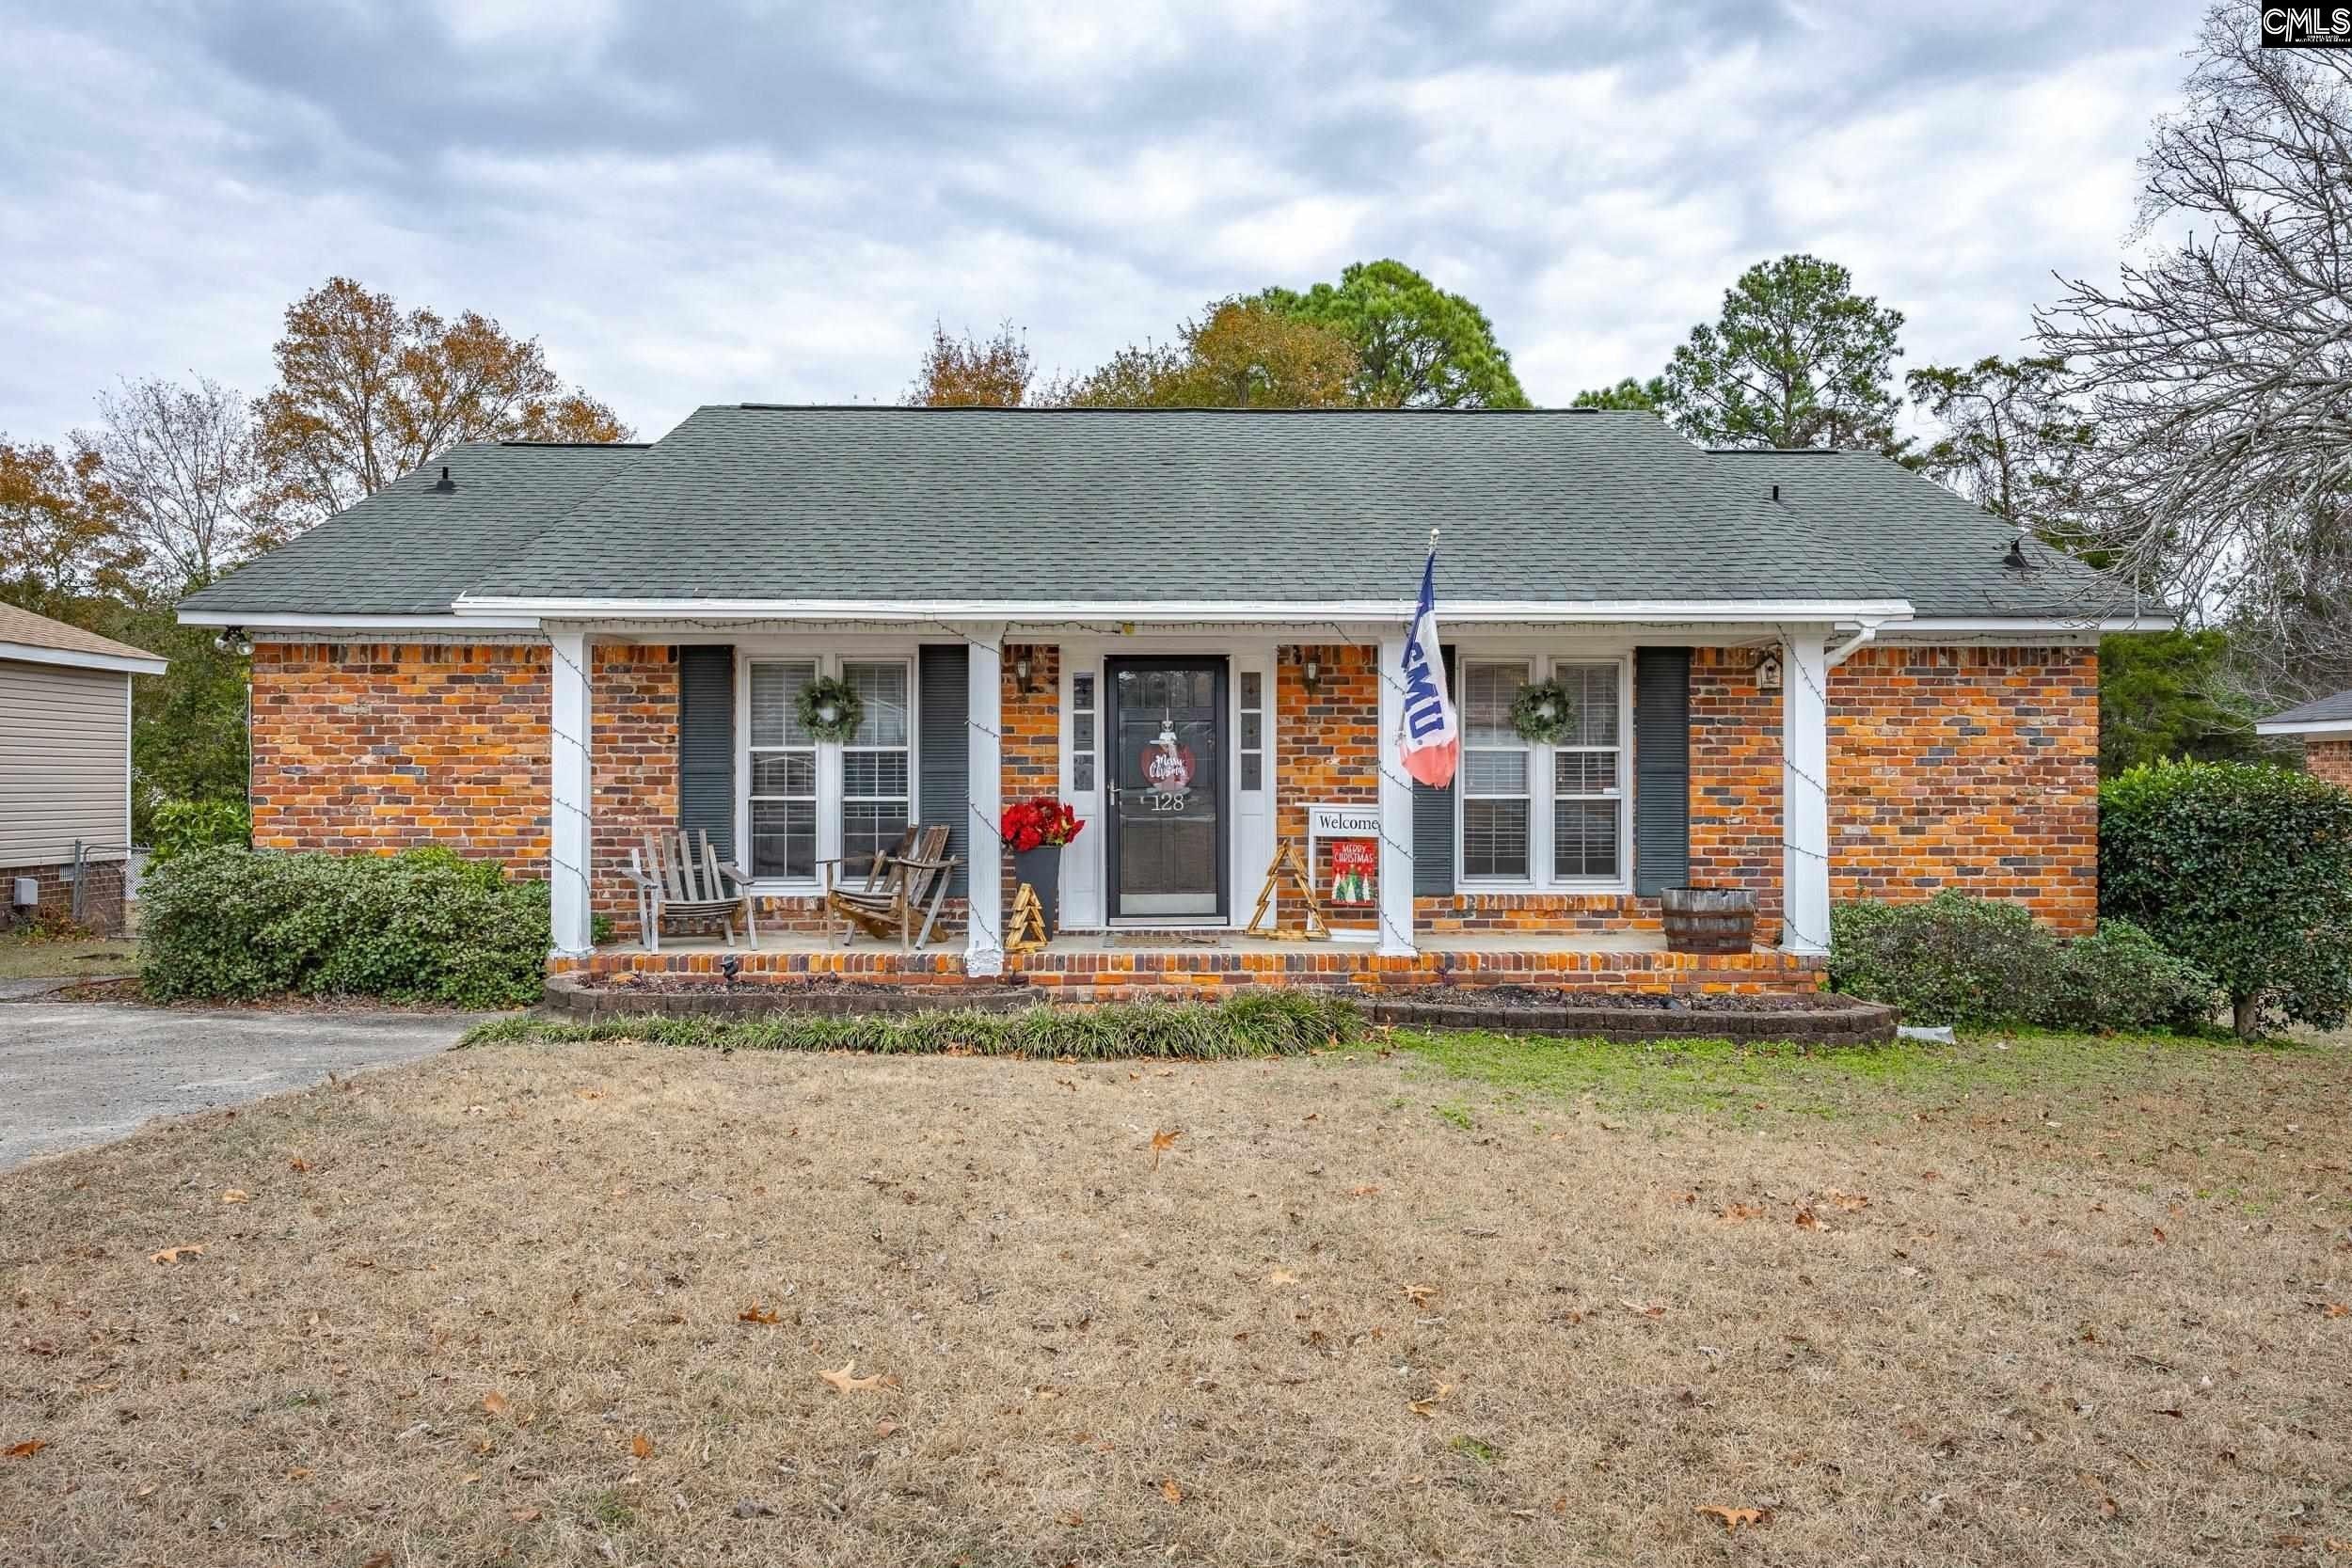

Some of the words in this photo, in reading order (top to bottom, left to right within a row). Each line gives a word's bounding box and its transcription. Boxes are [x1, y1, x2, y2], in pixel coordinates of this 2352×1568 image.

[1155, 753, 1184, 768] Merry
[1149, 762, 1188, 780] Christmas
[1151, 793, 1184, 811] 128
[1319, 813, 1380, 831] Welcome
[1342, 843, 1367, 854] MERRY
[1334, 851, 1374, 863] CHRISTMAS
